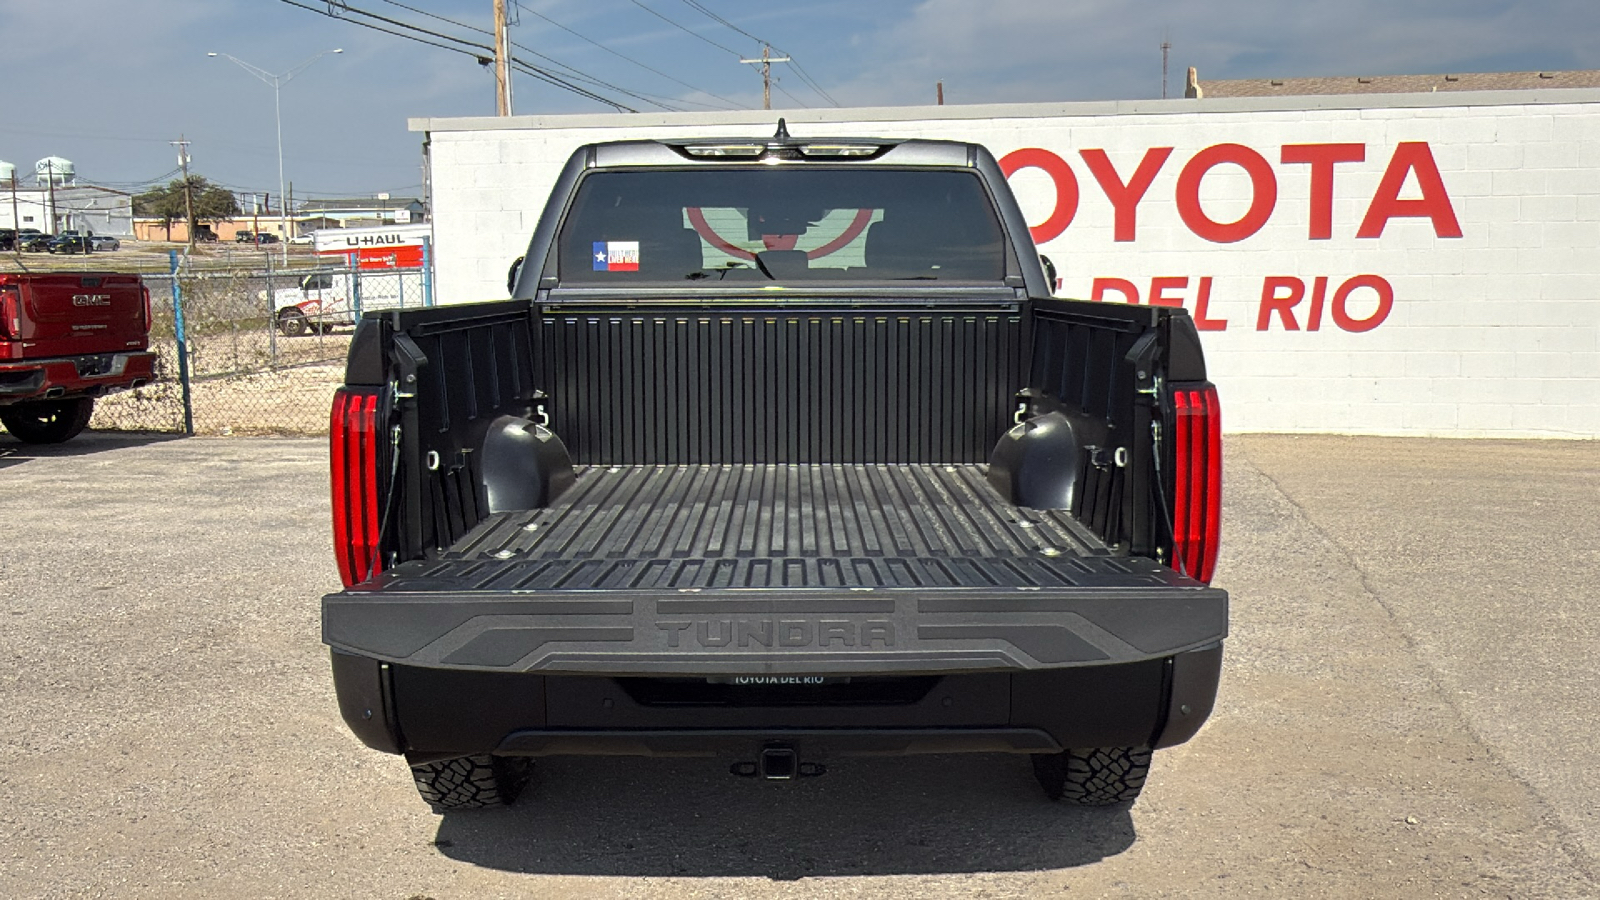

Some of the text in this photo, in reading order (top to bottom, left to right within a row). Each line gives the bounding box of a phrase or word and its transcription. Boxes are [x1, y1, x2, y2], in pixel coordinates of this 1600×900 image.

[998, 142, 1463, 244] OYOTA
[346, 234, 405, 246] U-HAUL
[72, 294, 111, 306] GMC
[1256, 274, 1394, 333] RIO
[655, 620, 896, 648] TUNDRA
[780, 676, 801, 684] DEL
[804, 676, 824, 684] RIO
